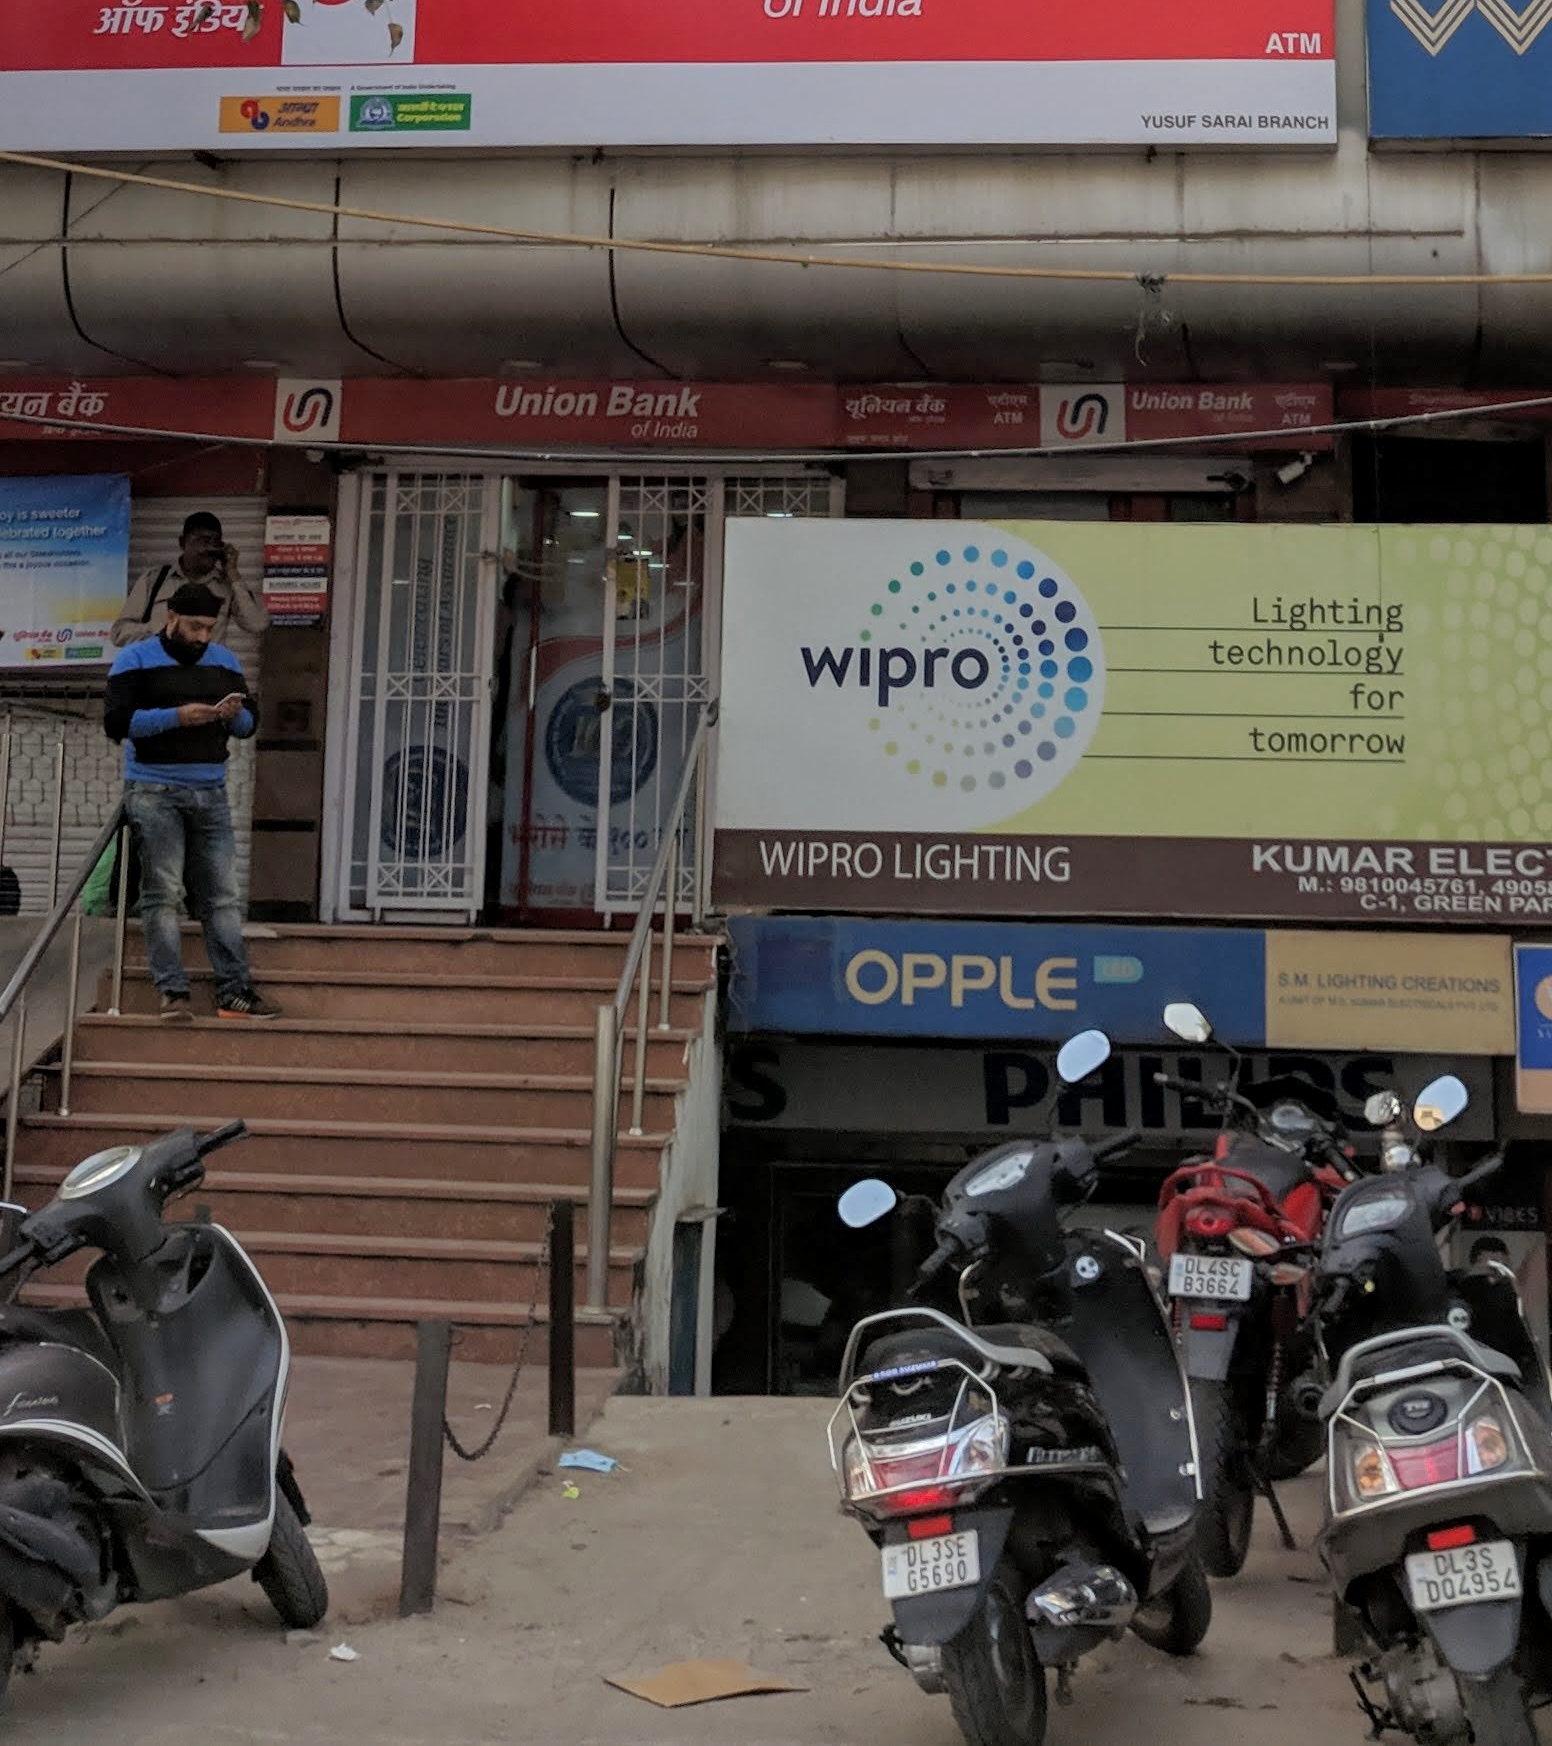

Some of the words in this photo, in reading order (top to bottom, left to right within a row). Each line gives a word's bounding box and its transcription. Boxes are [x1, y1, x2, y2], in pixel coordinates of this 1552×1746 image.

[1265, 32, 1323, 56] ATM
[1140, 115, 1197, 129] YUSUF
[1202, 115, 1254, 129] SARAI
[1257, 114, 1329, 129] BRANCH
[57, 381, 109, 417] बैंक
[495, 385, 597, 416] Union
[607, 385, 702, 418] Bank
[1132, 391, 1193, 411] Union
[1199, 391, 1255, 411] Bank
[632, 422, 652, 438] of
[654, 421, 698, 439] India
[994, 411, 1023, 425] ATM
[1282, 413, 1312, 426] ATM
[1252, 597, 1404, 632] Lighting
[1208, 637, 1405, 674] technology
[802, 645, 989, 707] wipro
[1349, 683, 1405, 712] for
[1249, 728, 1405, 755] tomorrow
[760, 841, 882, 879] WIPRO
[894, 844, 1071, 882] LIGHTING
[1252, 845, 1415, 874] KUMAR
[1360, 894, 1407, 914] C-1,
[1414, 895, 1502, 914] GREEN
[845, 949, 1078, 1011] OPPLE
[1316, 973, 1397, 992] LIGHTING
[1402, 975, 1501, 994] CREATIONS
[1185, 1258, 1241, 1277] DL4SC
[1183, 1275, 1239, 1296] B3664
[906, 1535, 968, 1567] DL3SE
[1433, 1547, 1494, 1577] DL3S
[907, 1559, 968, 1592] G5690
